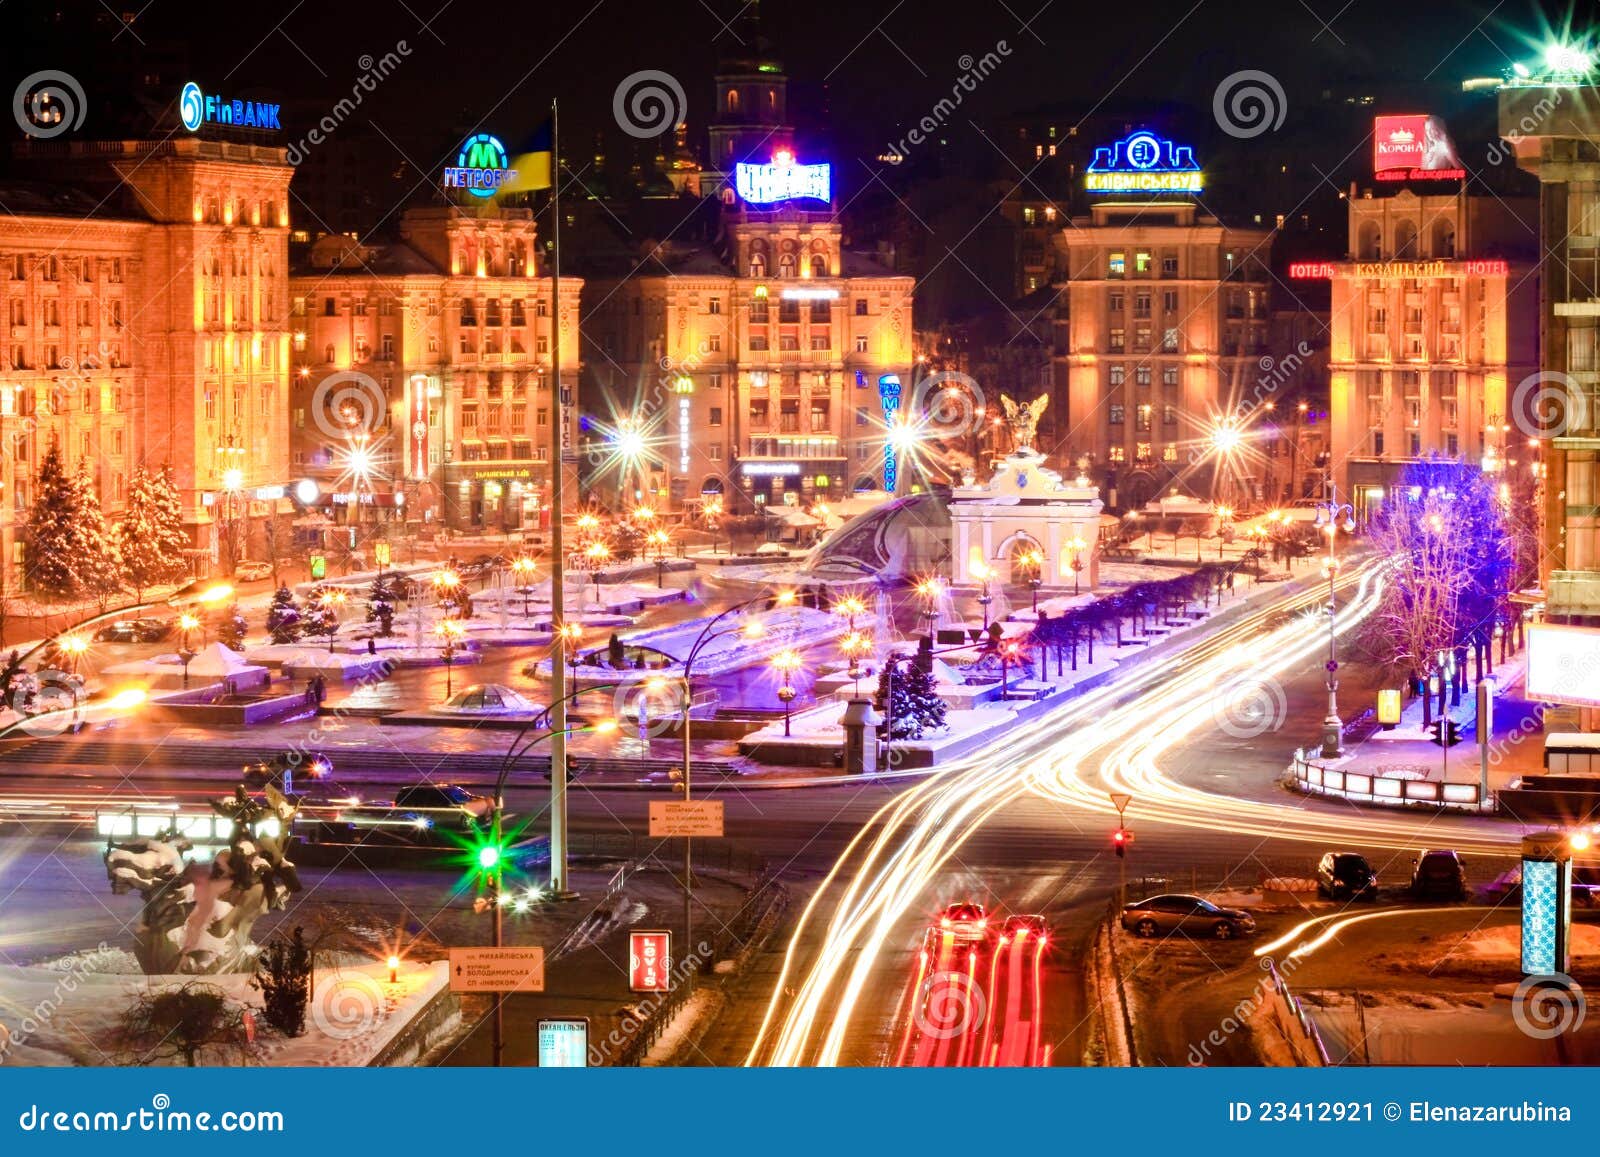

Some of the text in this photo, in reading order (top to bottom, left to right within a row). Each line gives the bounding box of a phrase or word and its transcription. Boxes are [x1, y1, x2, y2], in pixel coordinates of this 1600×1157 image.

[205, 94, 281, 130] FinBANK
[1290, 261, 1507, 277] ГОТЕЛЬ КОЗАЦЬКИЙ HOTEL
